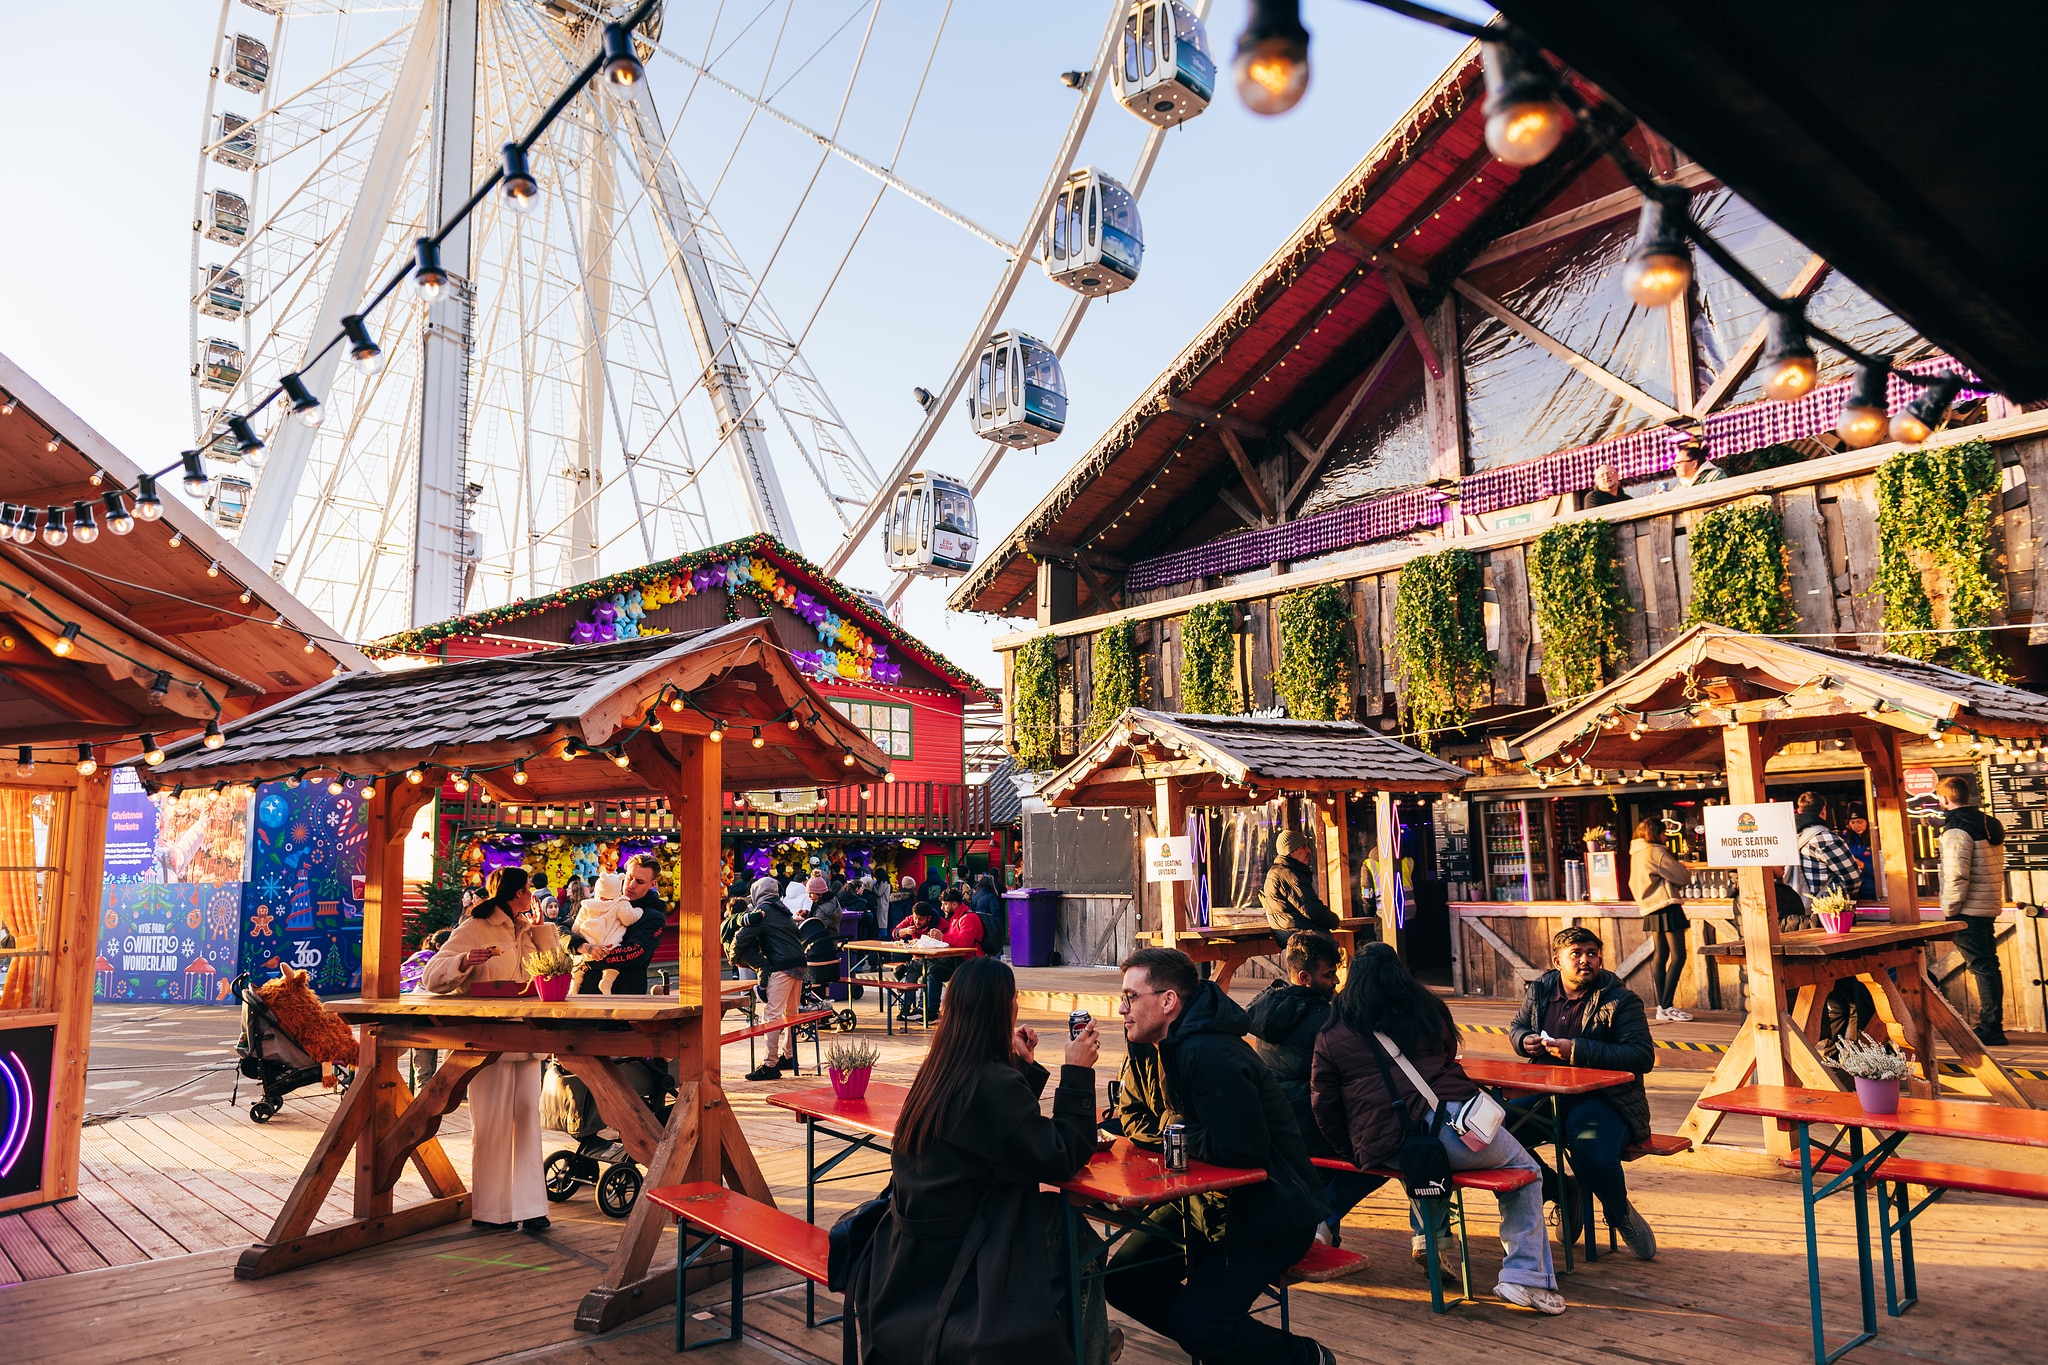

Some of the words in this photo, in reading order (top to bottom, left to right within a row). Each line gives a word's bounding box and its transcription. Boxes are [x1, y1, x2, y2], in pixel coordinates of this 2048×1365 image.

[1252, 705, 1284, 719] Inside
[112, 811, 143, 820] Christmas
[114, 822, 140, 832] Markets
[1721, 837, 1743, 847] MORE
[1745, 836, 1779, 846] SEATING
[1731, 849, 1769, 859] UPSTAIRS
[1153, 860, 1164, 868] MORE
[1164, 859, 1182, 867] SEATING
[1157, 868, 1177, 876] UPSTAIRS
[138, 923, 151, 934] HYDE
[151, 923, 166, 934] PARK
[123, 935, 179, 954] WINTER
[290, 940, 322, 968] 360
[122, 955, 178, 972] WONDERLAND
[1414, 1187, 1441, 1196] PUMA
